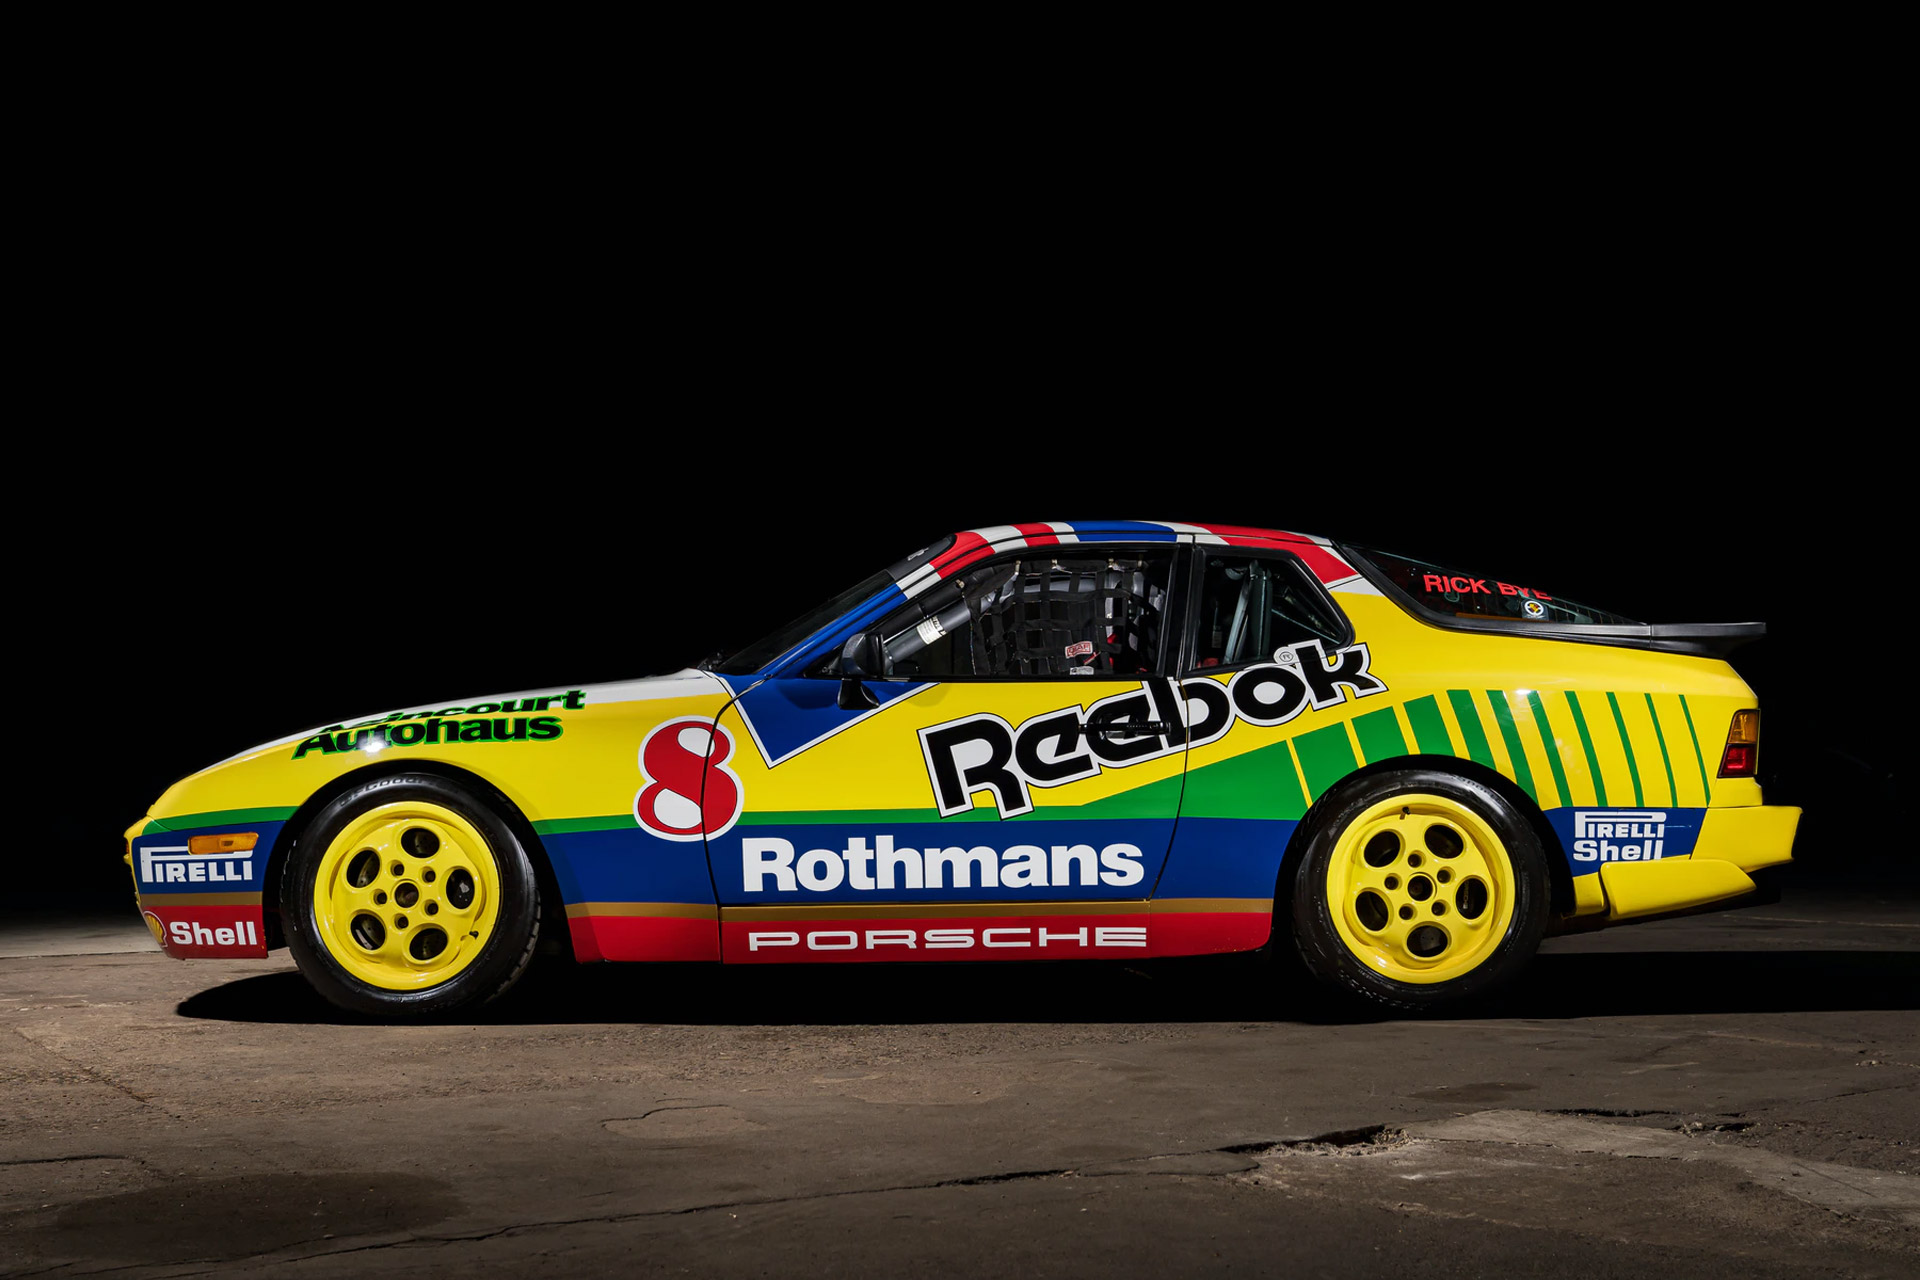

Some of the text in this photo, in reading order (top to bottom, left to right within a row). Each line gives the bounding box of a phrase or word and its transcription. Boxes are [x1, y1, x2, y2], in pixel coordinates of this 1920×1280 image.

[1423, 574, 1492, 595] RICK
[291, 715, 563, 760] Autohaus
[918, 638, 1389, 820] Reebok
[632, 714, 745, 843] 8
[1574, 811, 1667, 838] PIRELLI
[139, 845, 254, 883] PIRELLI
[742, 834, 1146, 892] Rothmans
[1572, 840, 1664, 861] Shell
[169, 920, 258, 946] Shell
[748, 926, 1147, 952] PORSCHE
